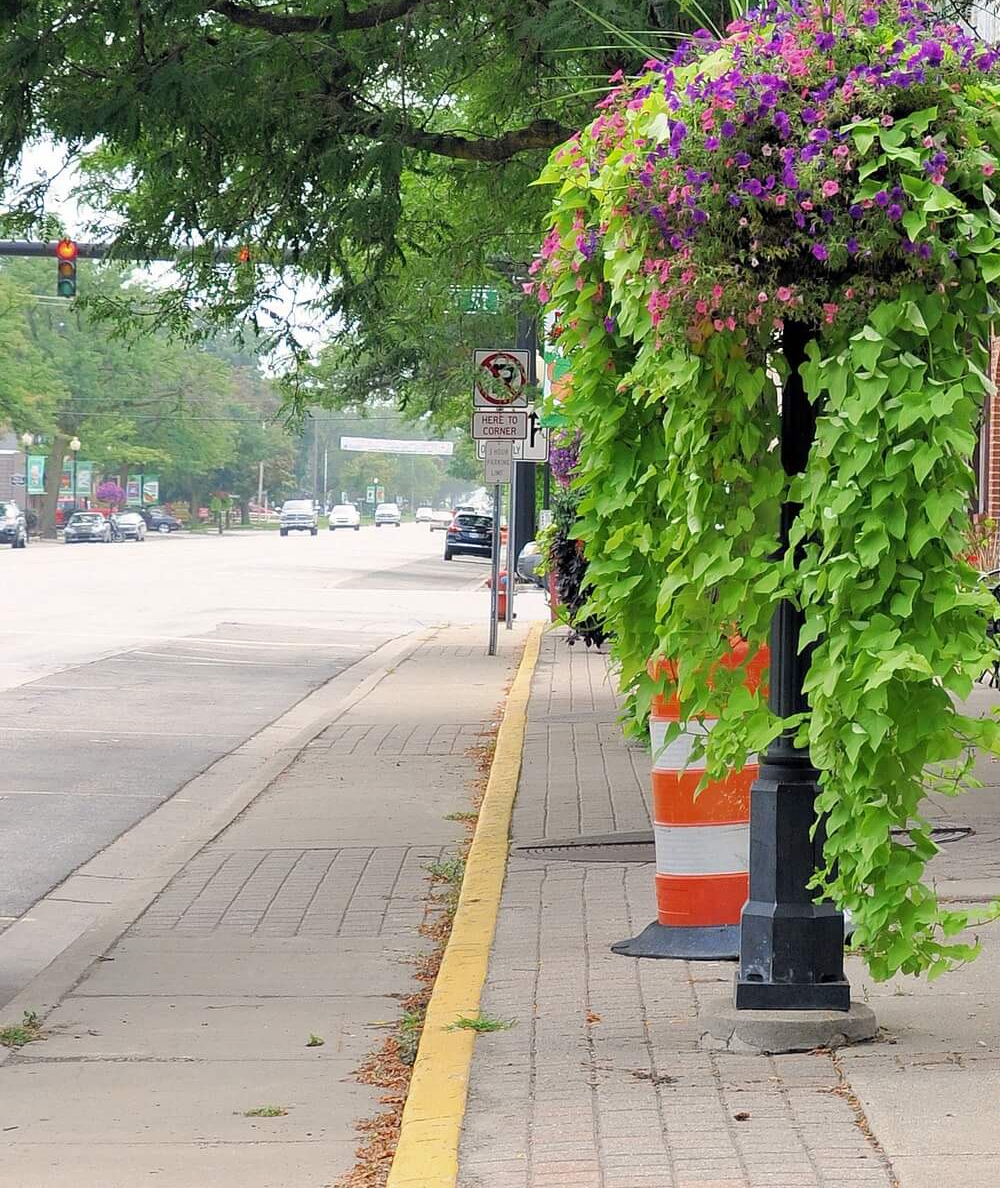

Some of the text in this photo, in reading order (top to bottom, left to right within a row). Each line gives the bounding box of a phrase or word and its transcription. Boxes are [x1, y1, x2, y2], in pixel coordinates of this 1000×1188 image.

[481, 416, 518, 424] HERE TO
[483, 427, 517, 435] CORNER
